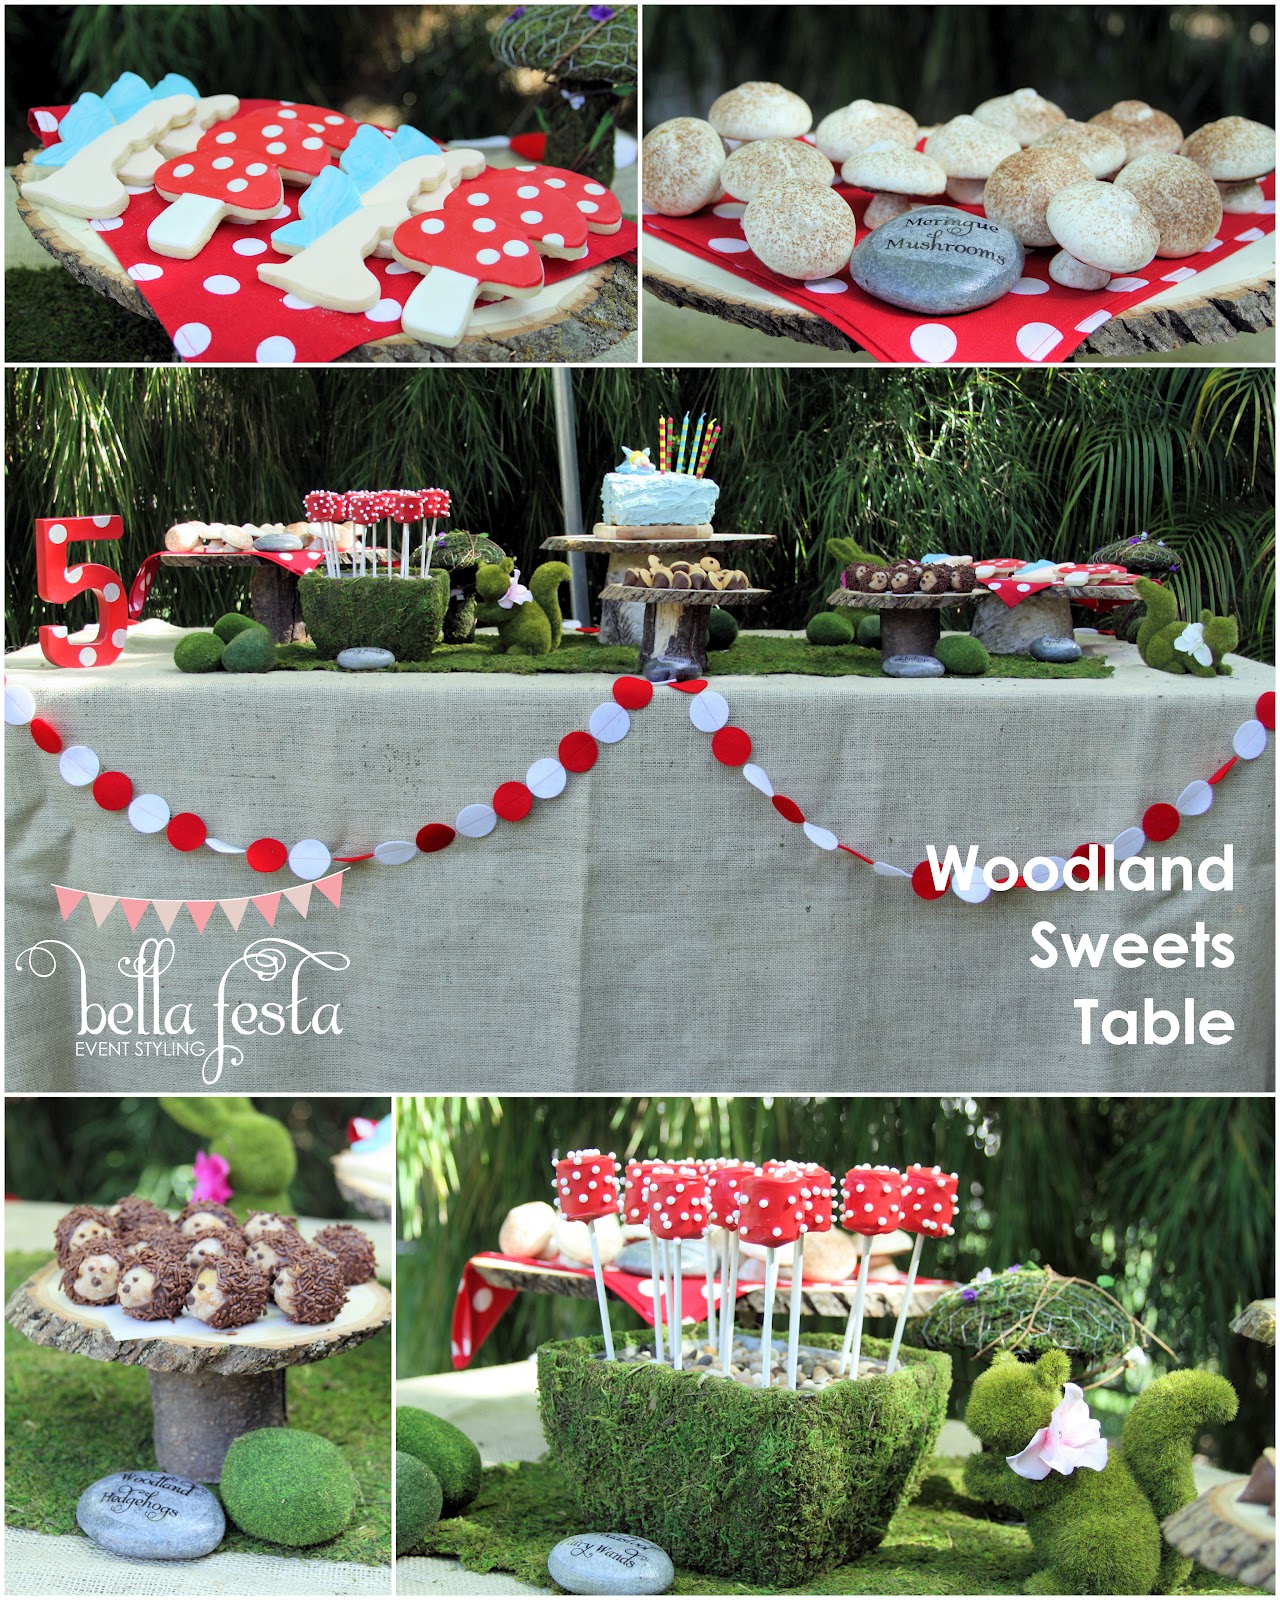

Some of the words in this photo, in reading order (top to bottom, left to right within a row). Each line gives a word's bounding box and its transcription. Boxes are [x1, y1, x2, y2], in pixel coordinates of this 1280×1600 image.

[905, 217, 999, 236] Meringue
[885, 230, 1005, 265] Mushrooms
[35, 515, 129, 669] 5
[122, 1472, 208, 1497] Woodland
[100, 1485, 179, 1521] Hedgehogs
[595, 1545, 648, 1568] Wands
